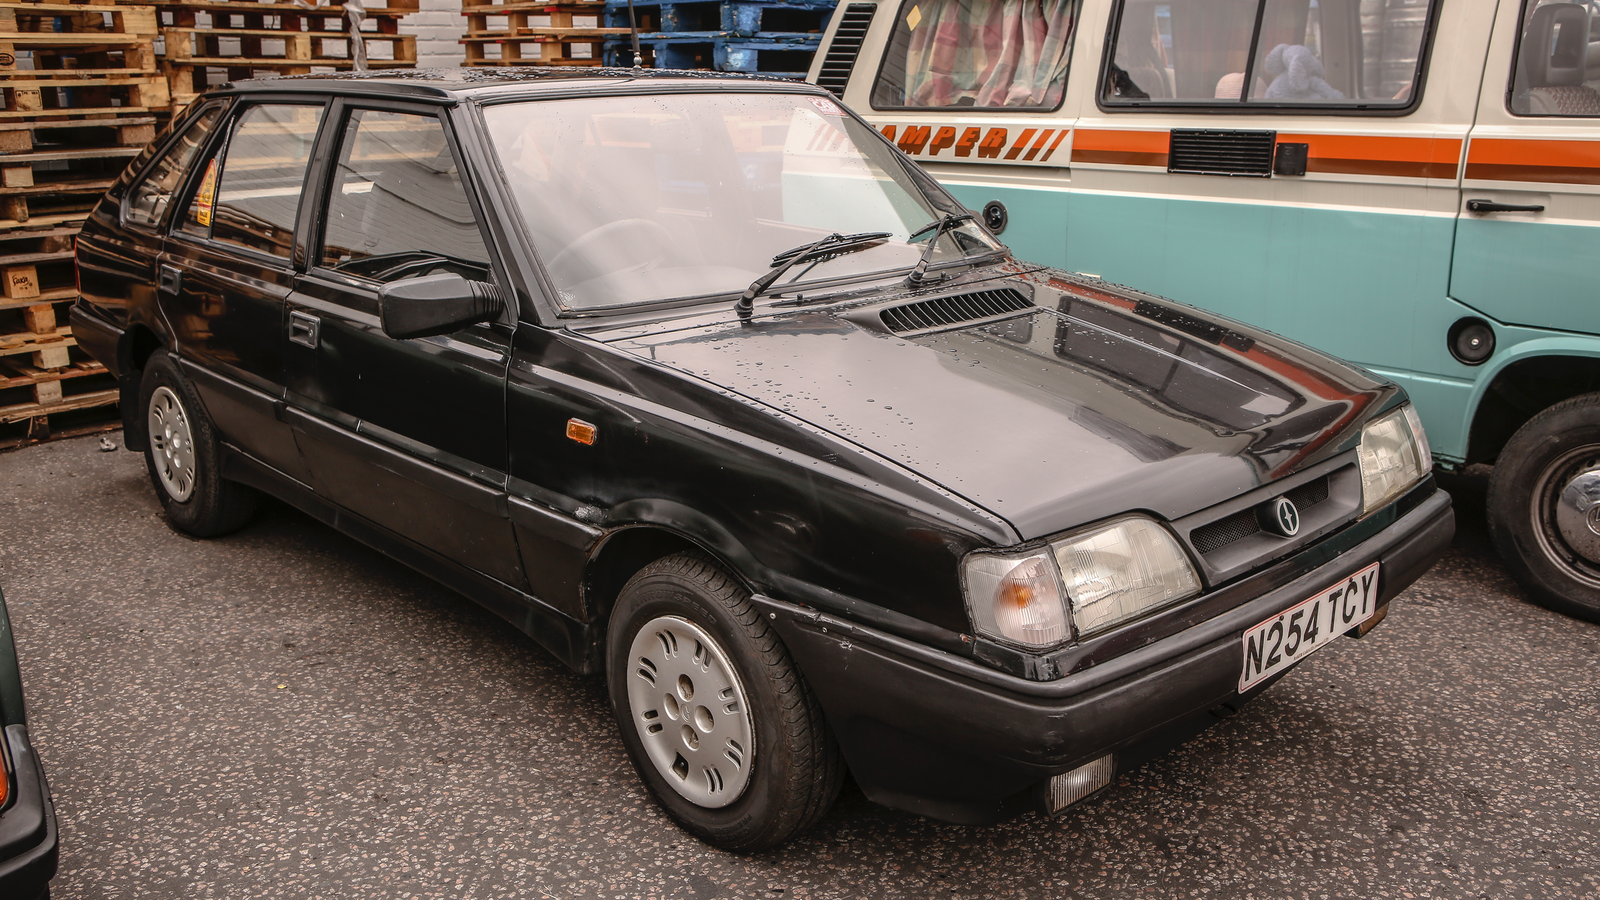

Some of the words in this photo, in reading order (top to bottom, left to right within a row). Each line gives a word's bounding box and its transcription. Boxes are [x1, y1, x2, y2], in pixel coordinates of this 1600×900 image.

[871, 124, 1008, 159] AMPER
[1244, 600, 1320, 682] N254
[1328, 569, 1376, 634] TCY
